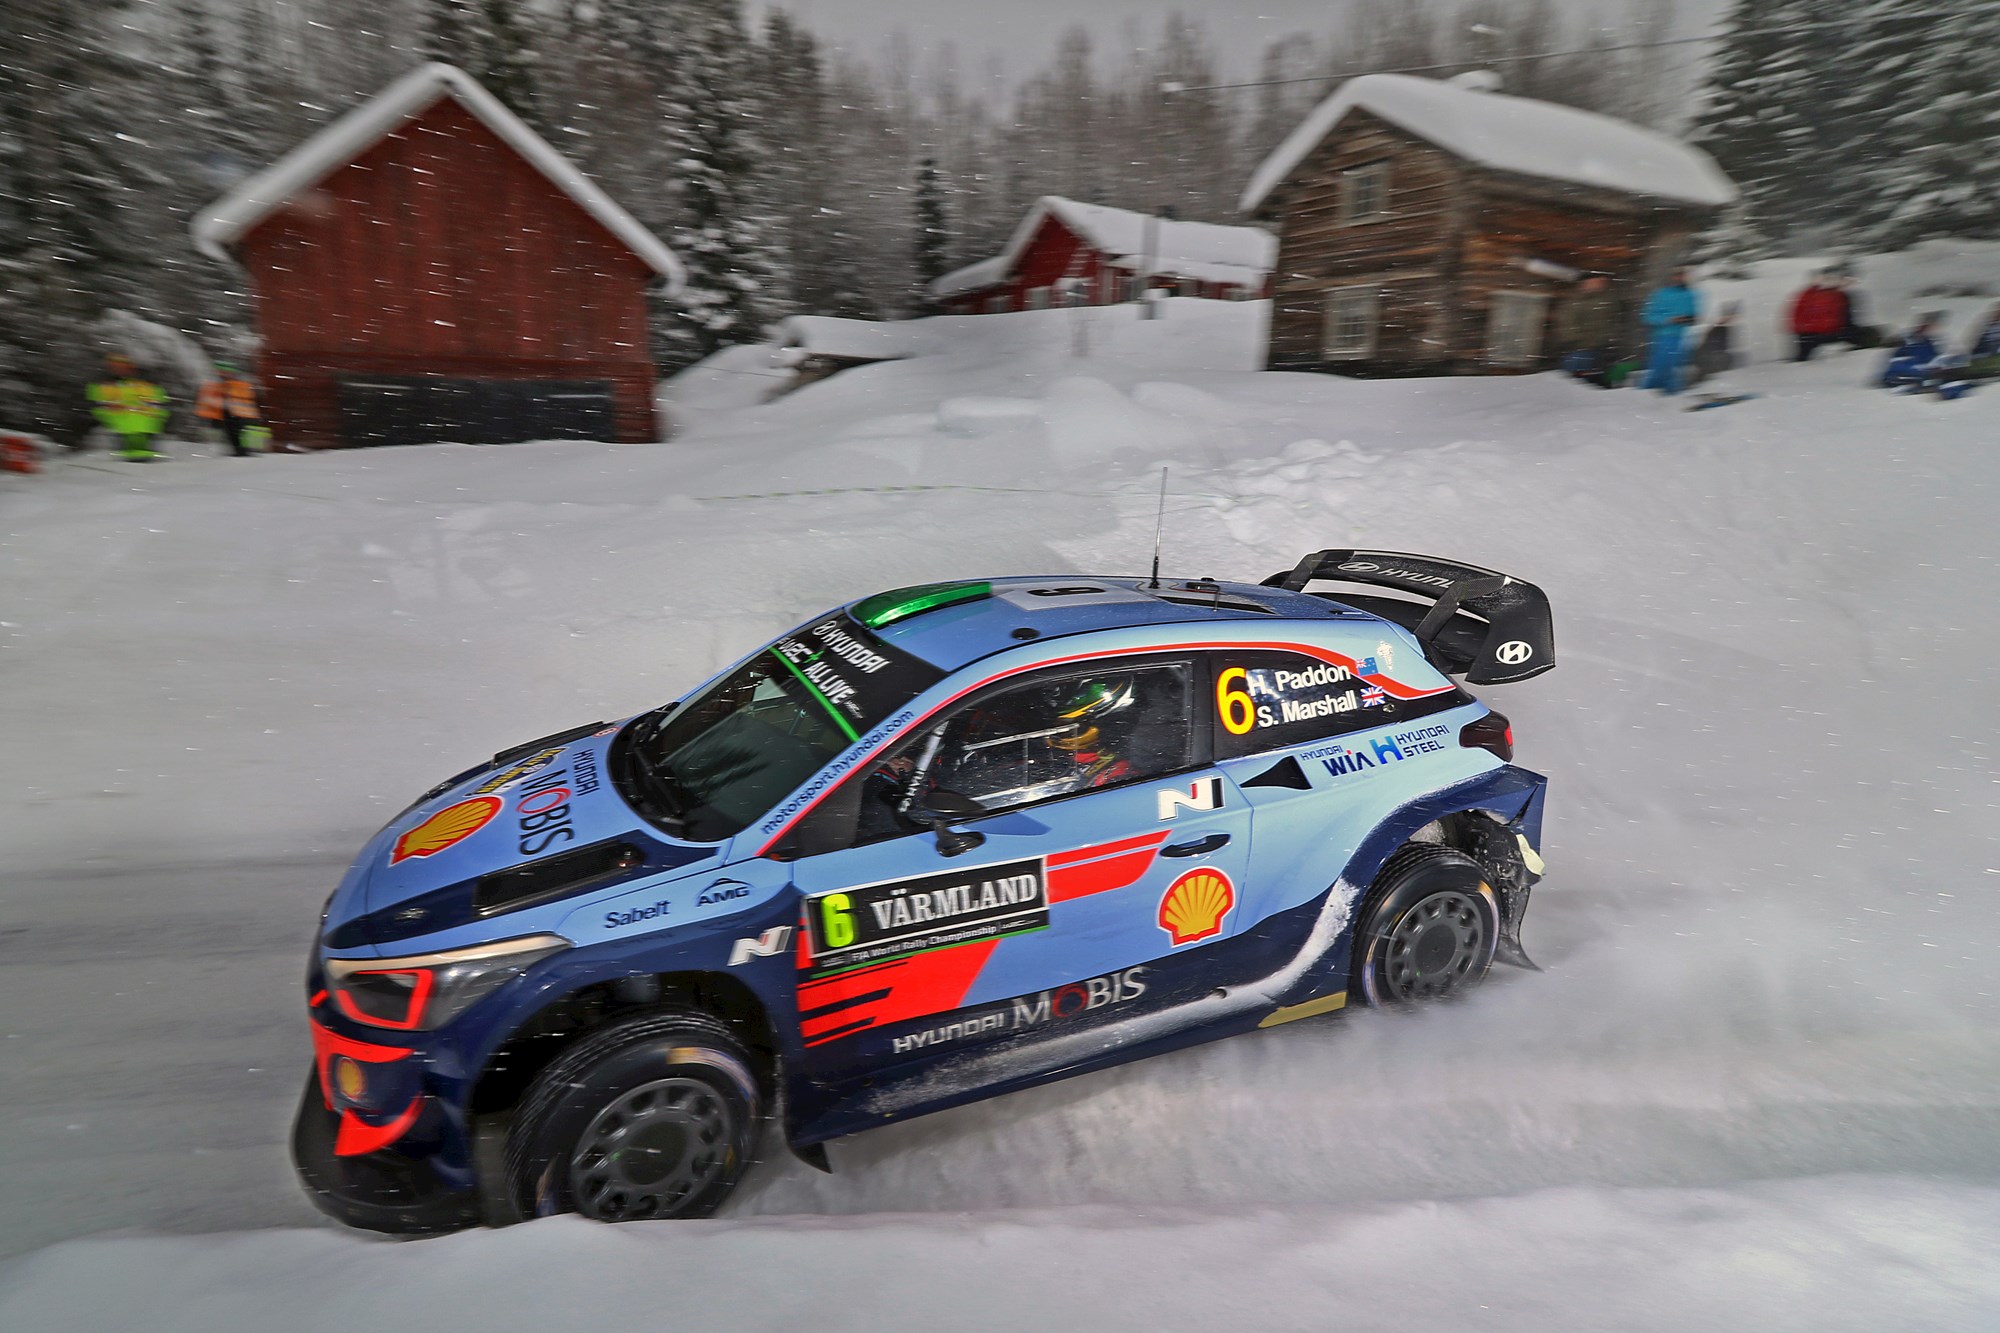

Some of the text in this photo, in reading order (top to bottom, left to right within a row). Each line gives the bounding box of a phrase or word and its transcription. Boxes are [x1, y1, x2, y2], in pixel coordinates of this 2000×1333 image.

[821, 628, 891, 674] HYUNDAI
[802, 661, 833, 684] ALL
[818, 674, 857, 705] LIVE
[1216, 661, 1351, 735] 6 H. Paddon
[1257, 690, 1358, 729] S. Marshall
[1300, 744, 1344, 761] HYUNDAI
[1394, 724, 1451, 746] HYUNDAI
[1402, 739, 1446, 758] STEEL
[572, 748, 600, 797] HYUNDAI
[761, 708, 914, 836] motorsport.hyundai.com
[515, 768, 576, 856] MOBIS
[604, 899, 672, 929] Sabelt
[696, 886, 751, 908] AMG
[820, 873, 1039, 948] 6 VÄRMLAND
[928, 924, 997, 945] Championship
[892, 966, 1149, 1055] HYUNDAI MOBIS
